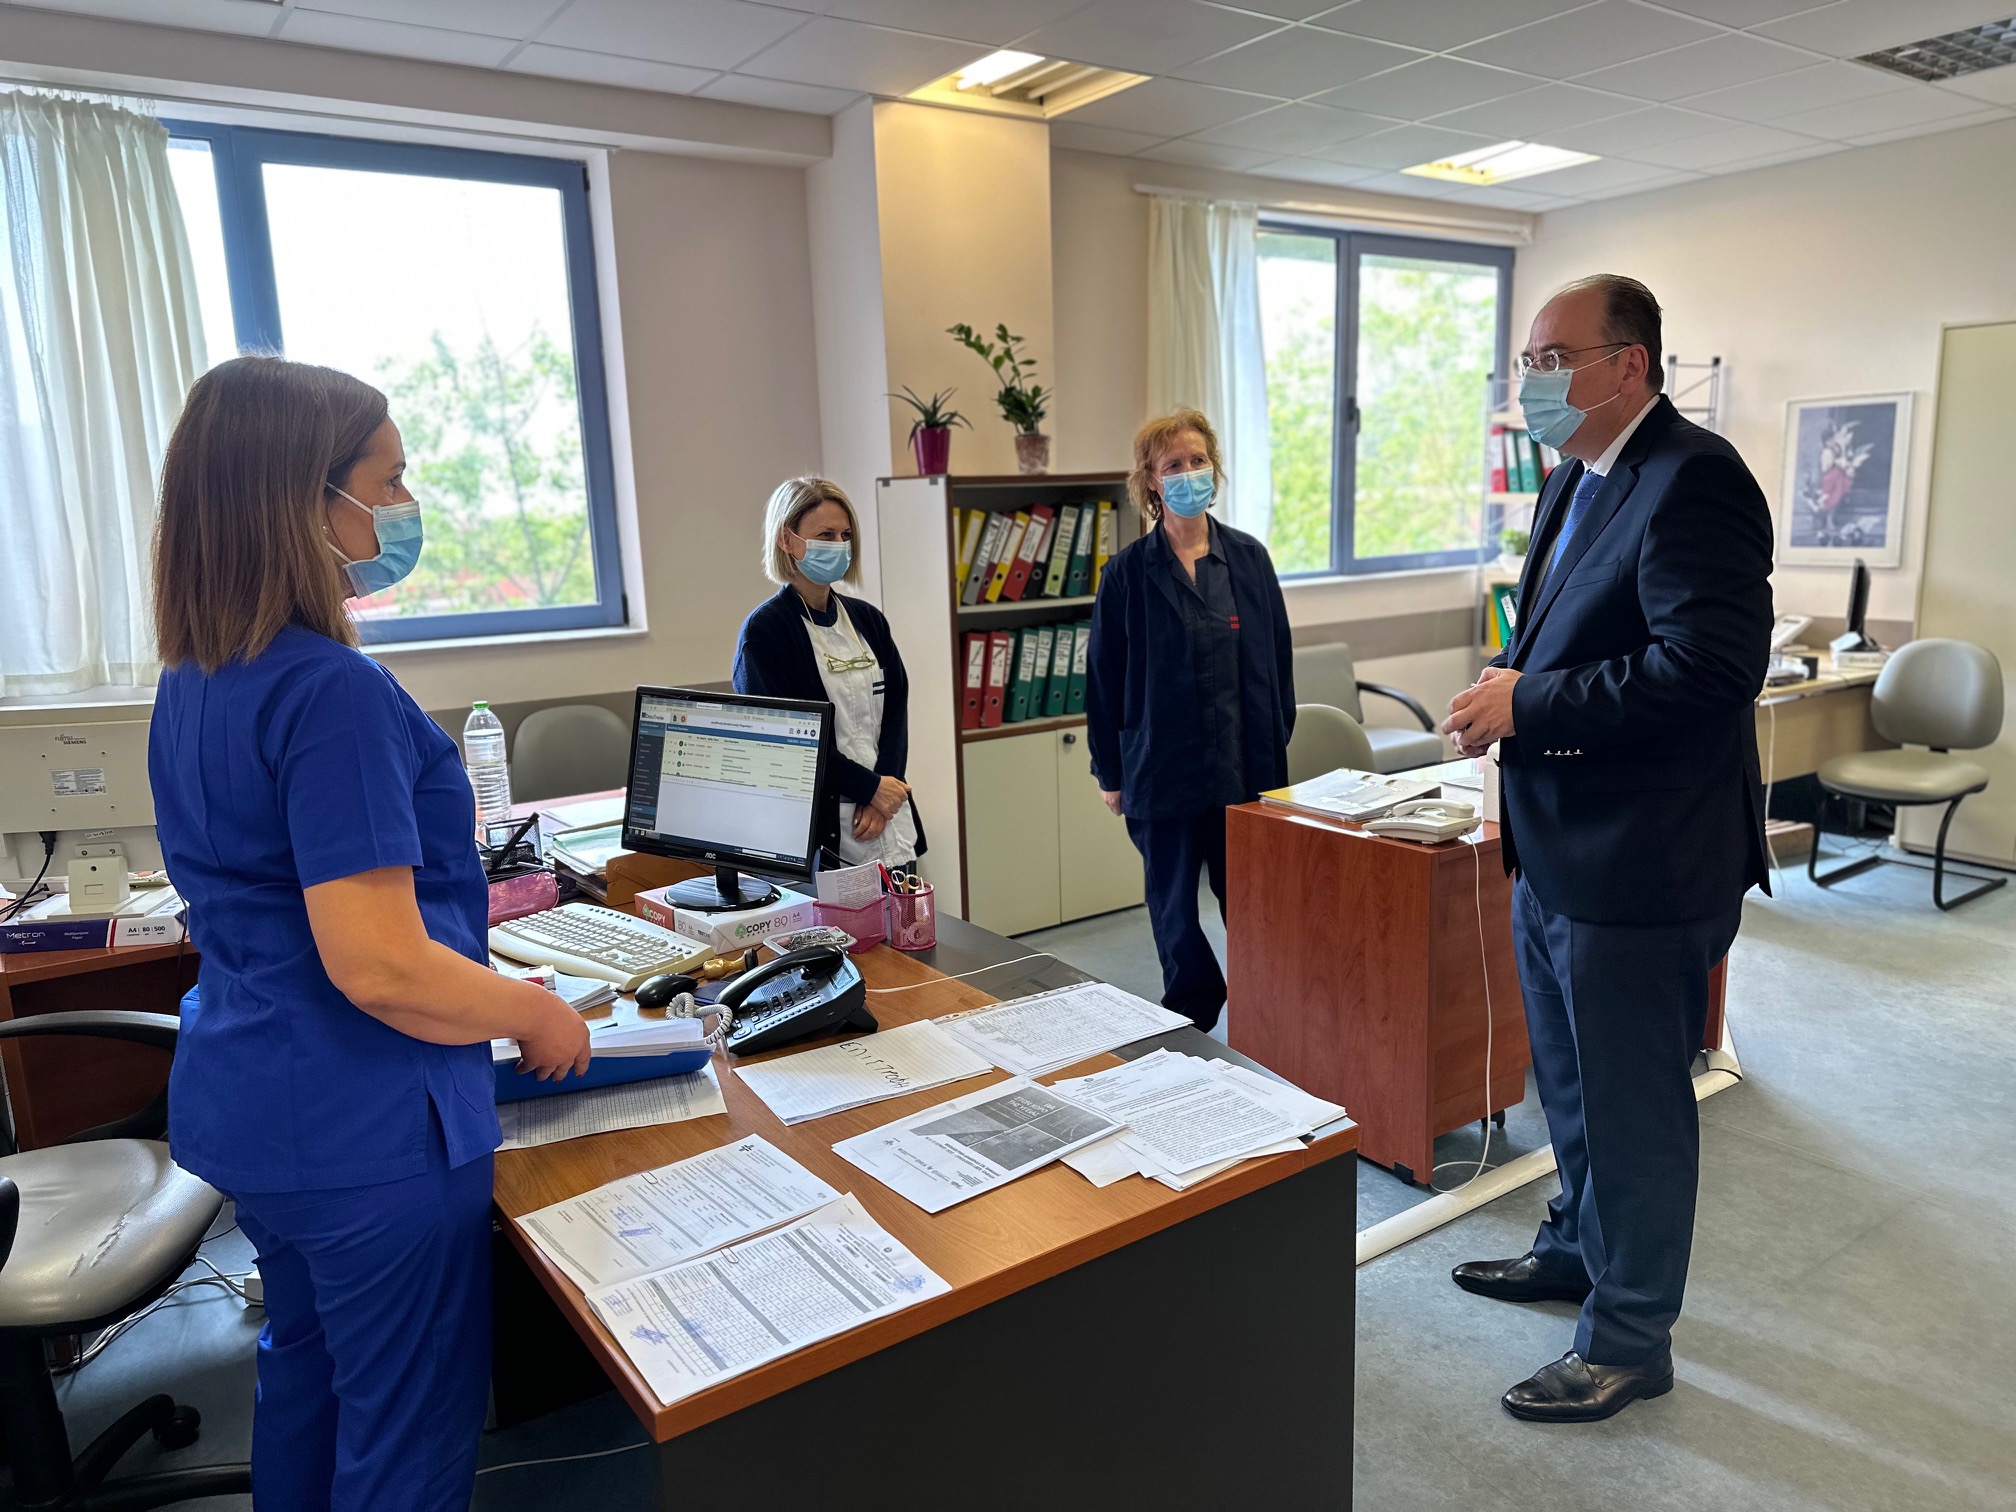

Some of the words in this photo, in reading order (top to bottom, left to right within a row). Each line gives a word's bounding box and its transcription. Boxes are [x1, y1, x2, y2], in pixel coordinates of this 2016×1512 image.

[705, 852, 716, 860] AOC
[649, 909, 666, 924] COPY
[678, 921, 686, 931] 80
[746, 920, 772, 933] COPY
[774, 915, 788, 928] 80
[6, 931, 46, 939] Metron
[747, 928, 771, 937] PAPER
